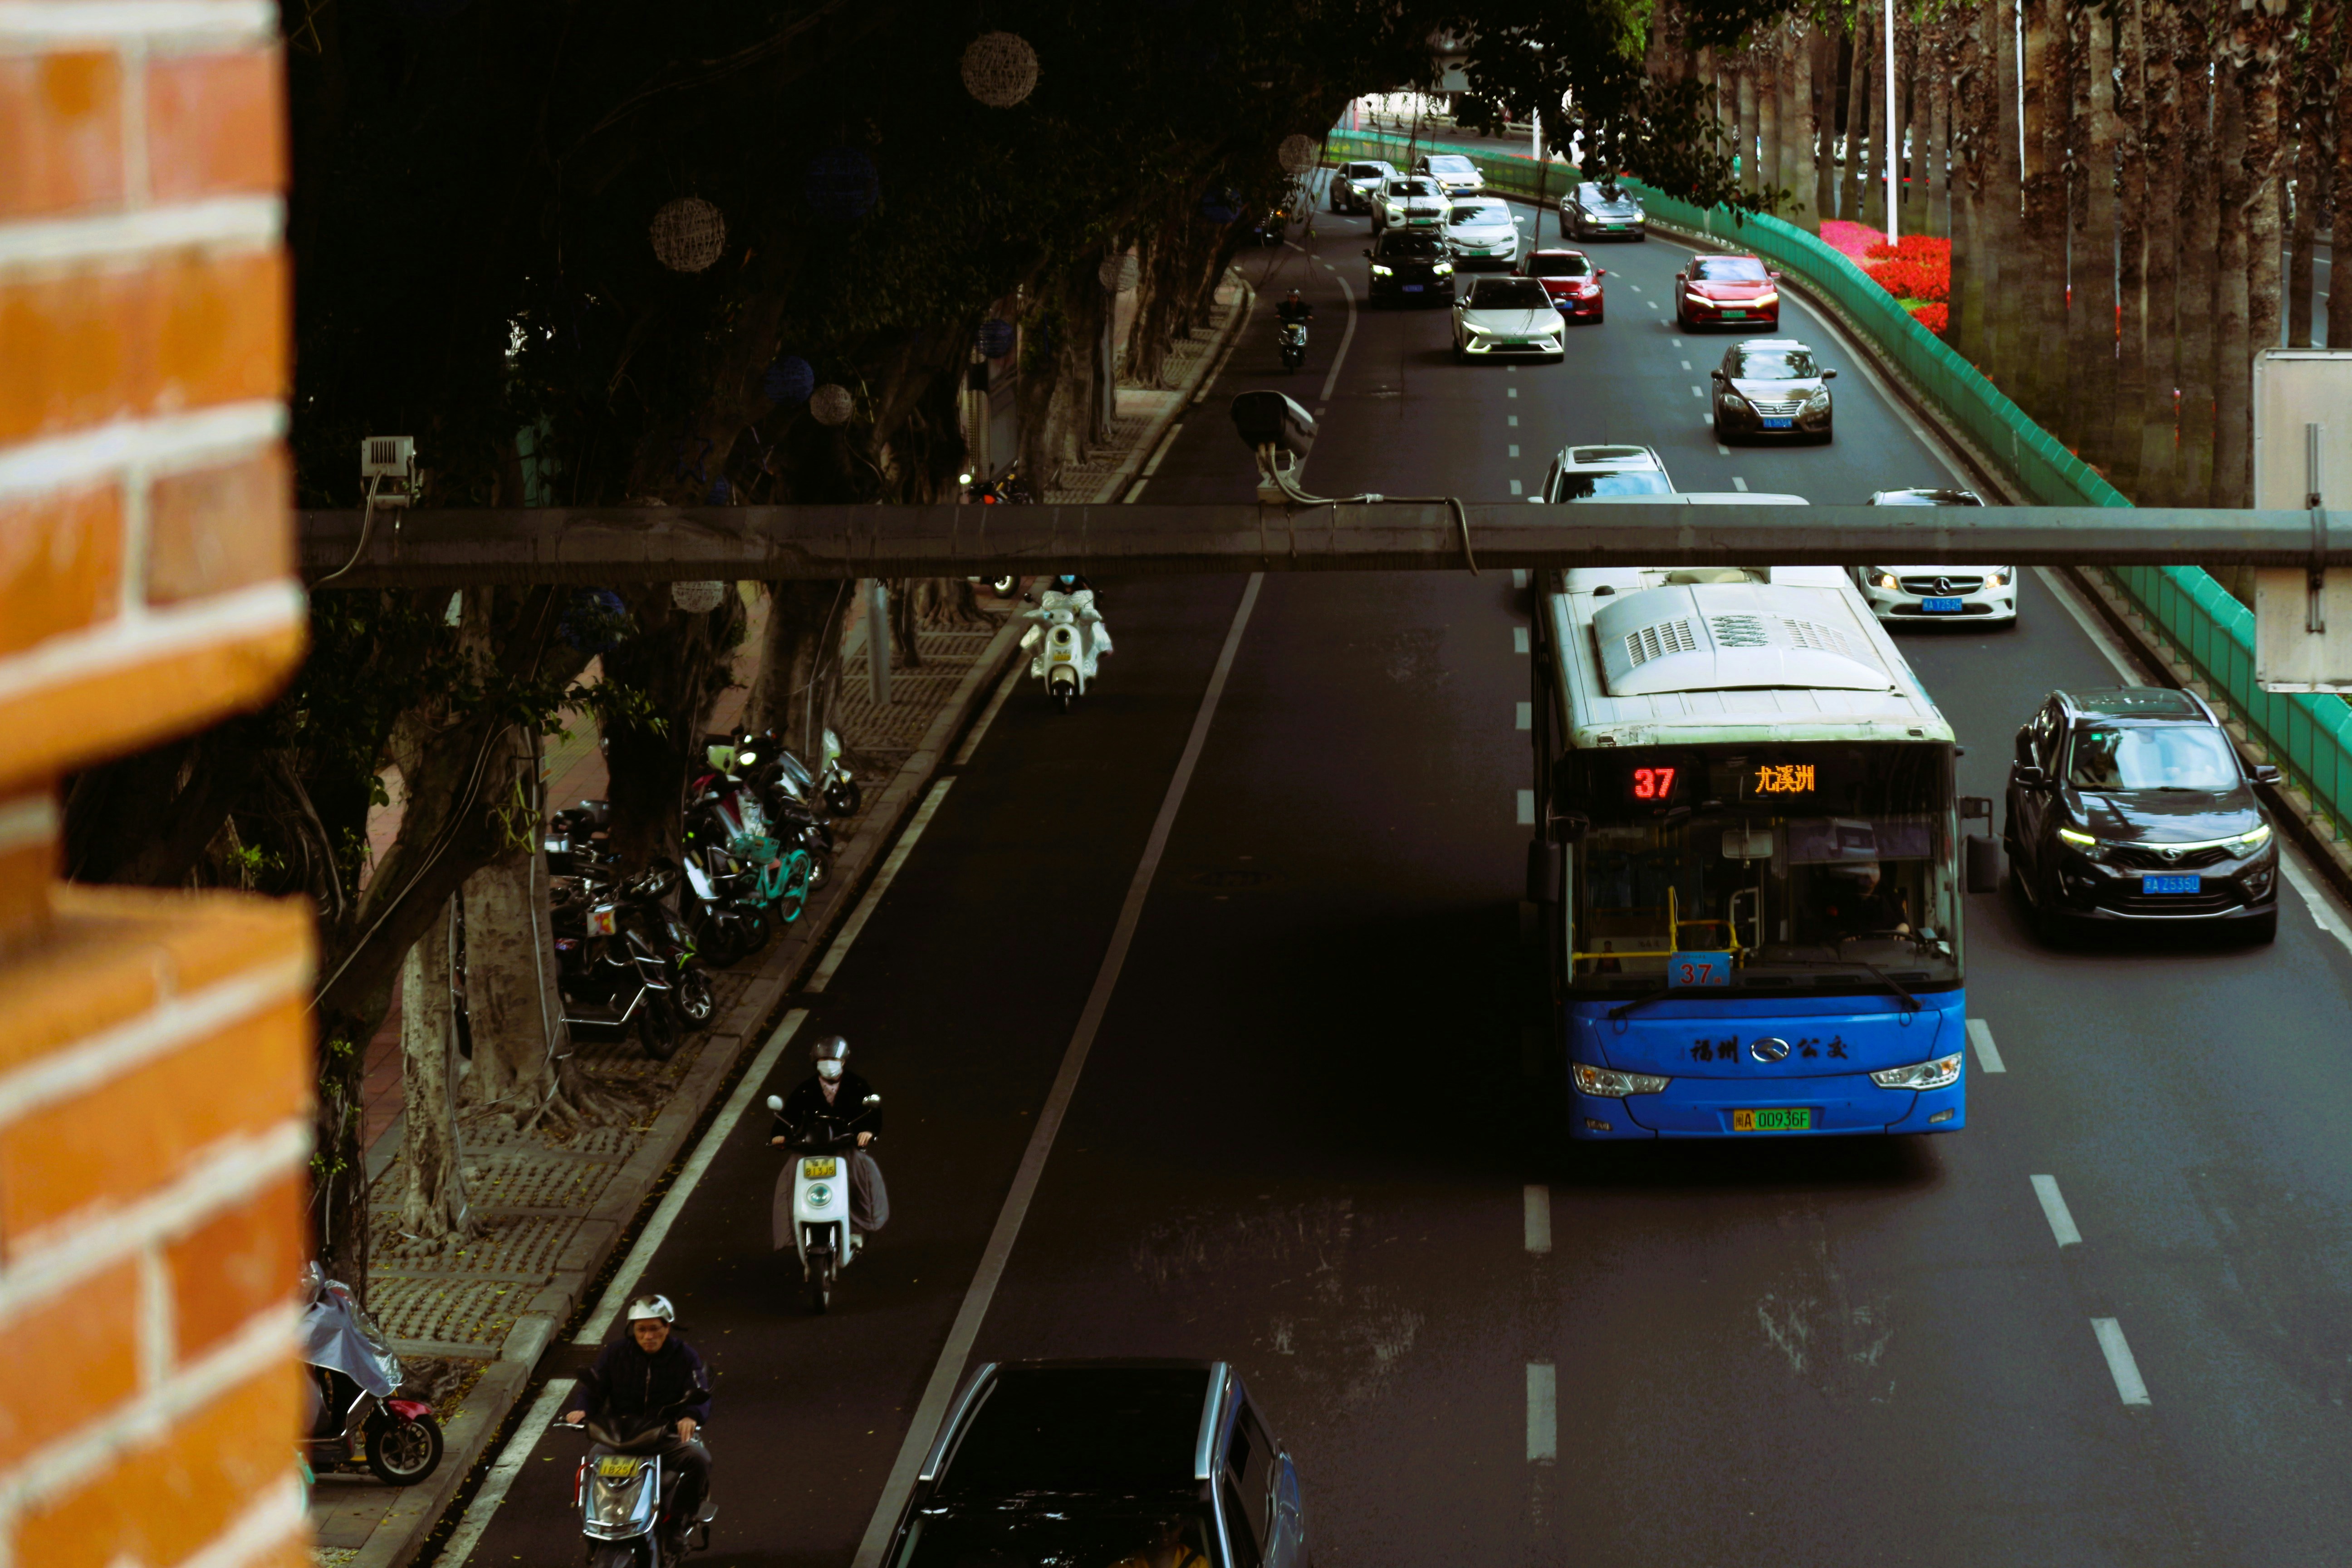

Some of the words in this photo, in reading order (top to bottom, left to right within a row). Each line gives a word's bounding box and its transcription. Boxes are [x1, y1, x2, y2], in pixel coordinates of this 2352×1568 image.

[1635, 769, 1674, 797] 37
[1755, 765, 1814, 792] 尤溪洲
[1681, 964, 1713, 984] 37
